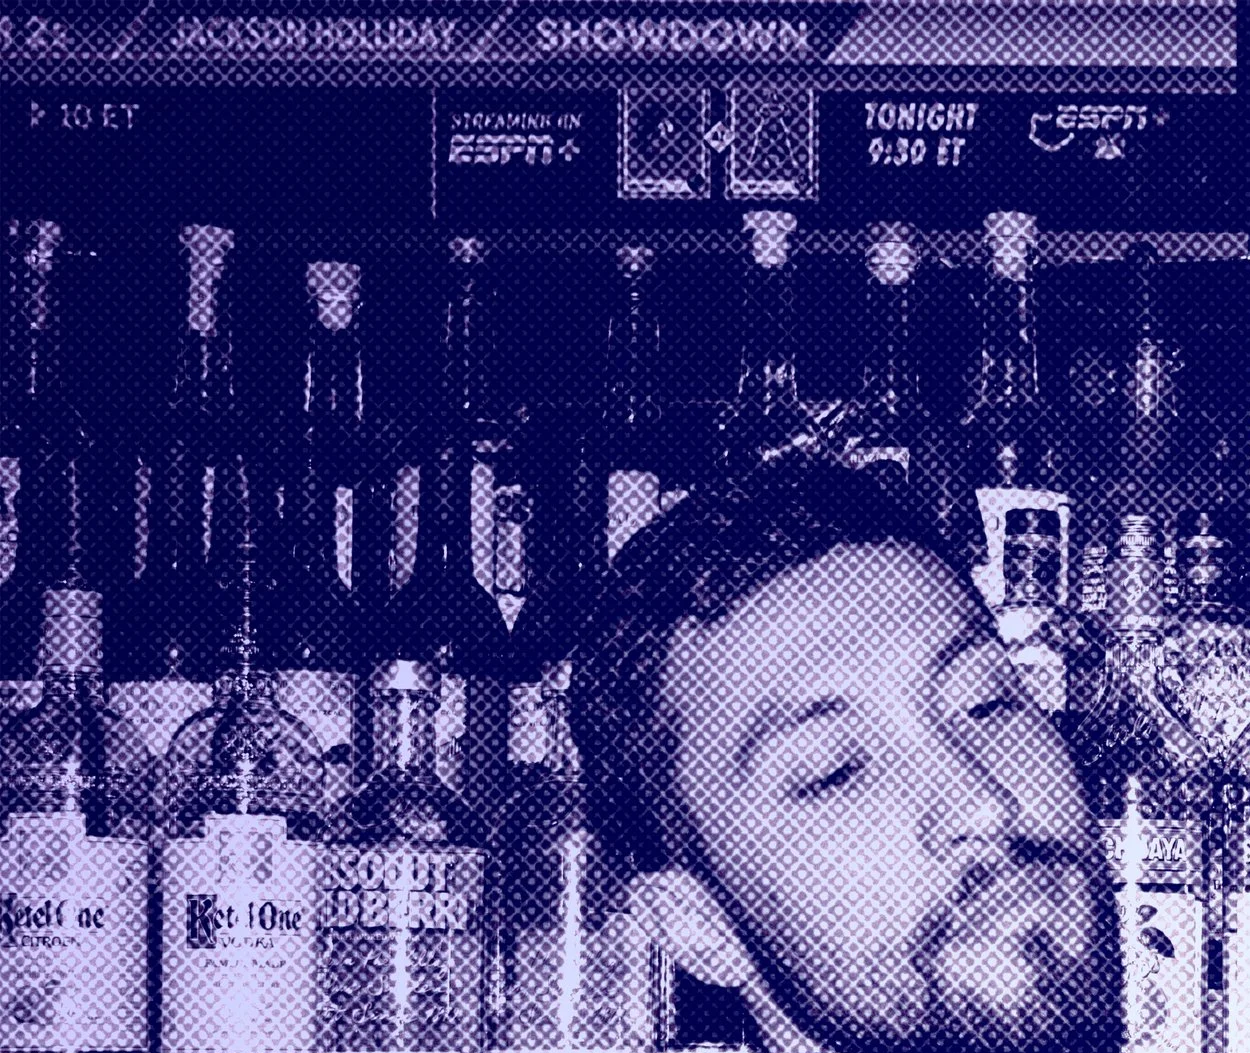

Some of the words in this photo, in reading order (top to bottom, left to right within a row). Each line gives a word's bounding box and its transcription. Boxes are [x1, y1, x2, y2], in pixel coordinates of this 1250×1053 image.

[171, 17, 310, 52] JACKSON
[314, 17, 457, 52] HOLLIDAY
[536, 17, 810, 53] SHOWDOWN
[60, 103, 93, 130] 10
[103, 103, 140, 130] ET
[451, 112, 551, 131] STREAMING
[556, 113, 583, 130] ON
[864, 102, 980, 131] TONIGHT
[448, 134, 581, 165] ESPN+
[868, 136, 928, 167] 9:30
[936, 136, 966, 167] ET
[1102, 835, 1187, 863] CHAYA
[187, 894, 254, 949] Ketl
[259, 899, 302, 932] One
